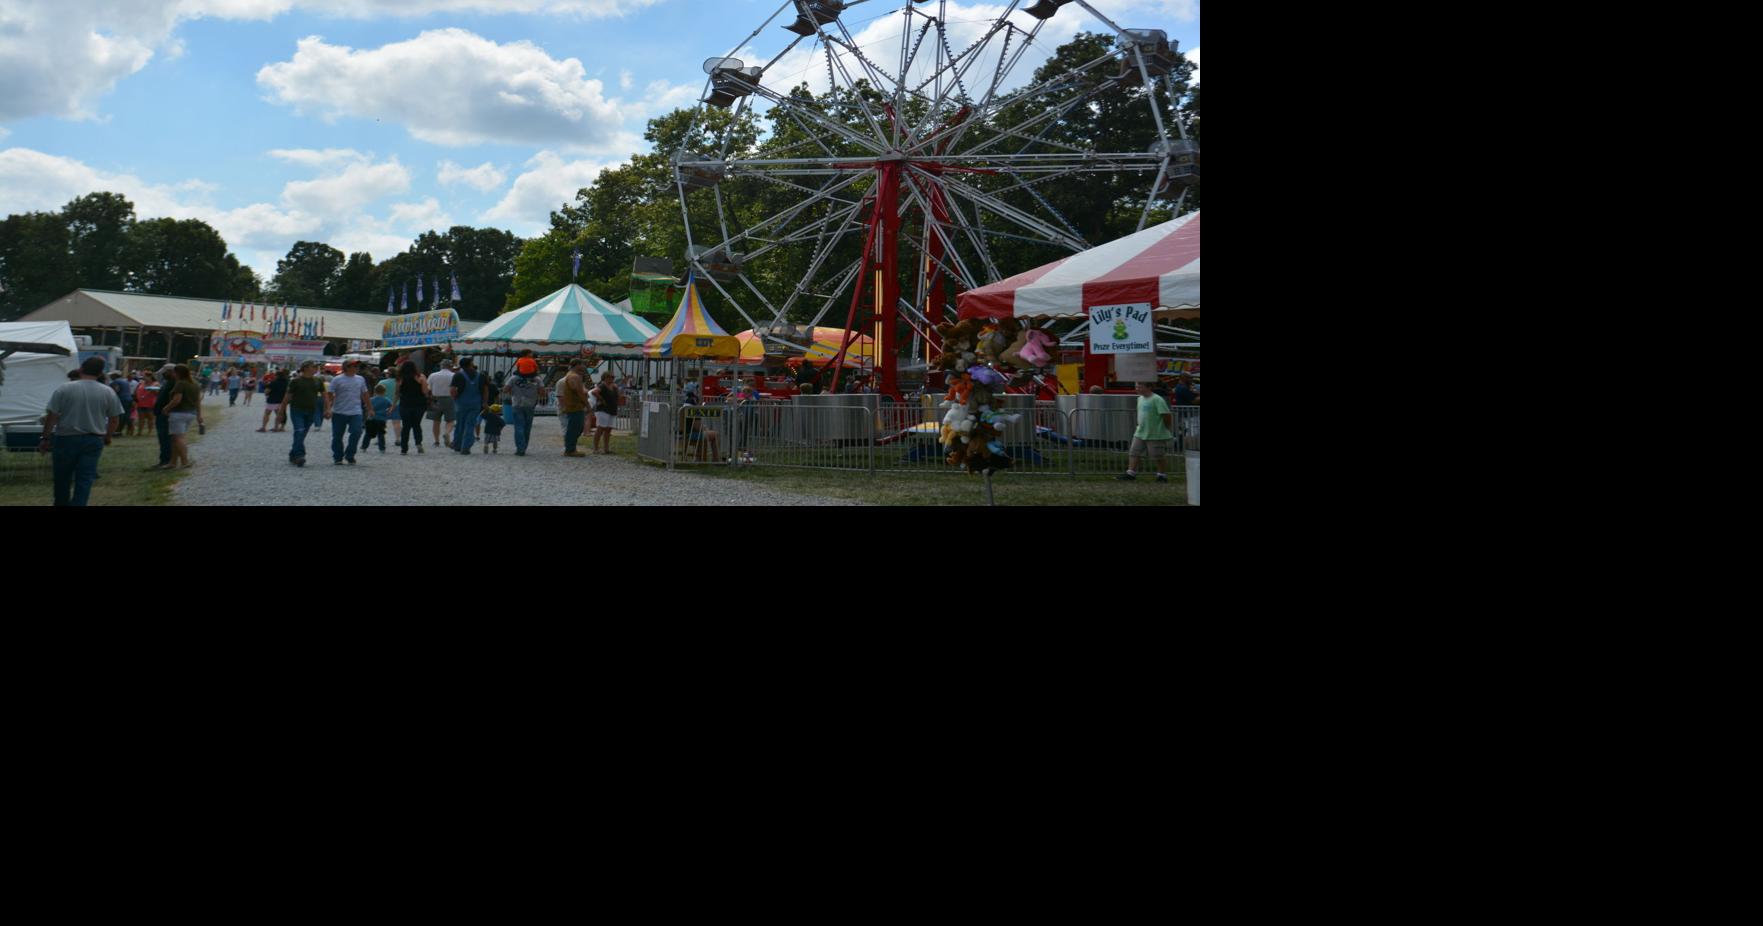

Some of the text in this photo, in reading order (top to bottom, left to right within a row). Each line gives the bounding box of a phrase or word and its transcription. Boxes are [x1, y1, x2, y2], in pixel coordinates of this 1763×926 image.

[1092, 306, 1148, 325] Lily's Pad
[1112, 341, 1150, 351] Everytime!
